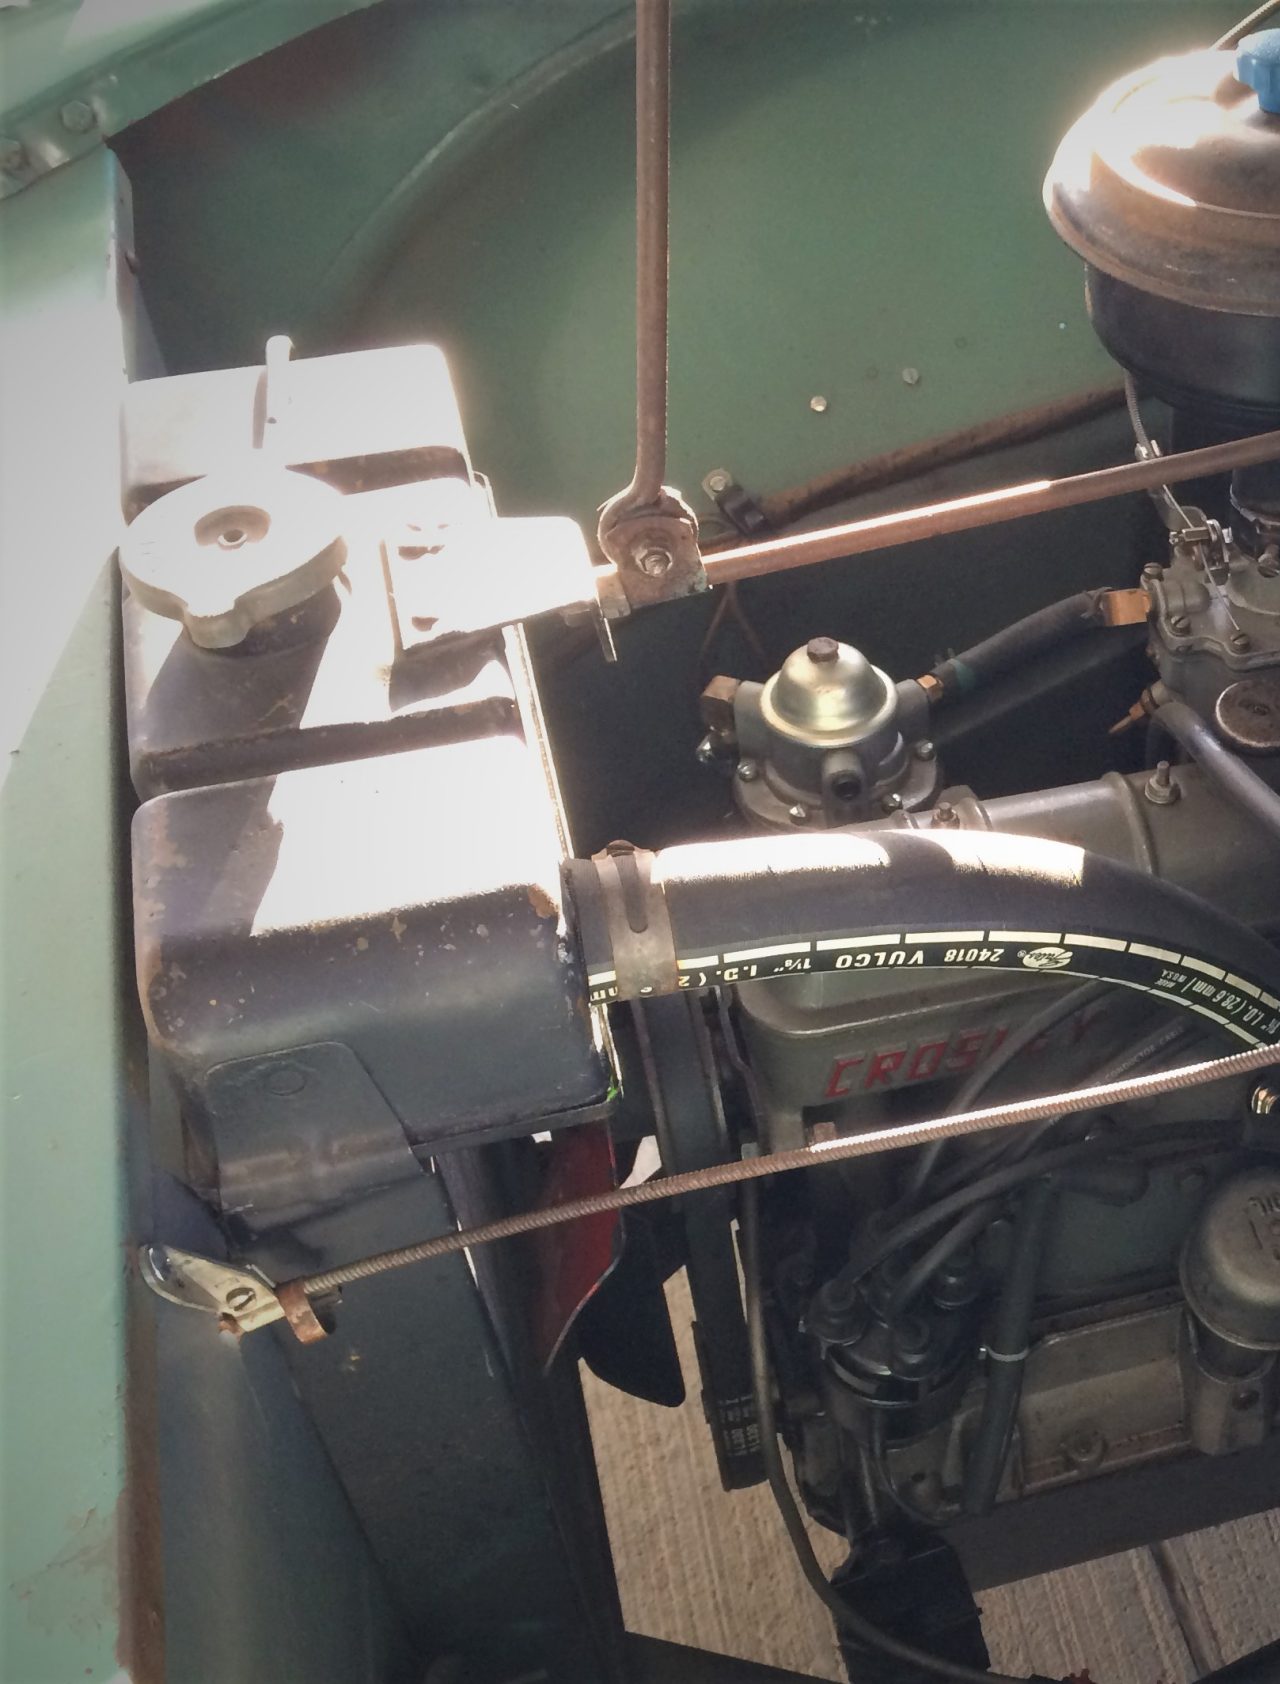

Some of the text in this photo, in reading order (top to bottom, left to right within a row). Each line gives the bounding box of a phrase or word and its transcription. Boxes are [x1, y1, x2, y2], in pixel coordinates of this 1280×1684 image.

[836, 950, 924, 968] VULCO
[943, 948, 1005, 962] 24018
[715, 964, 758, 982] I.D.
